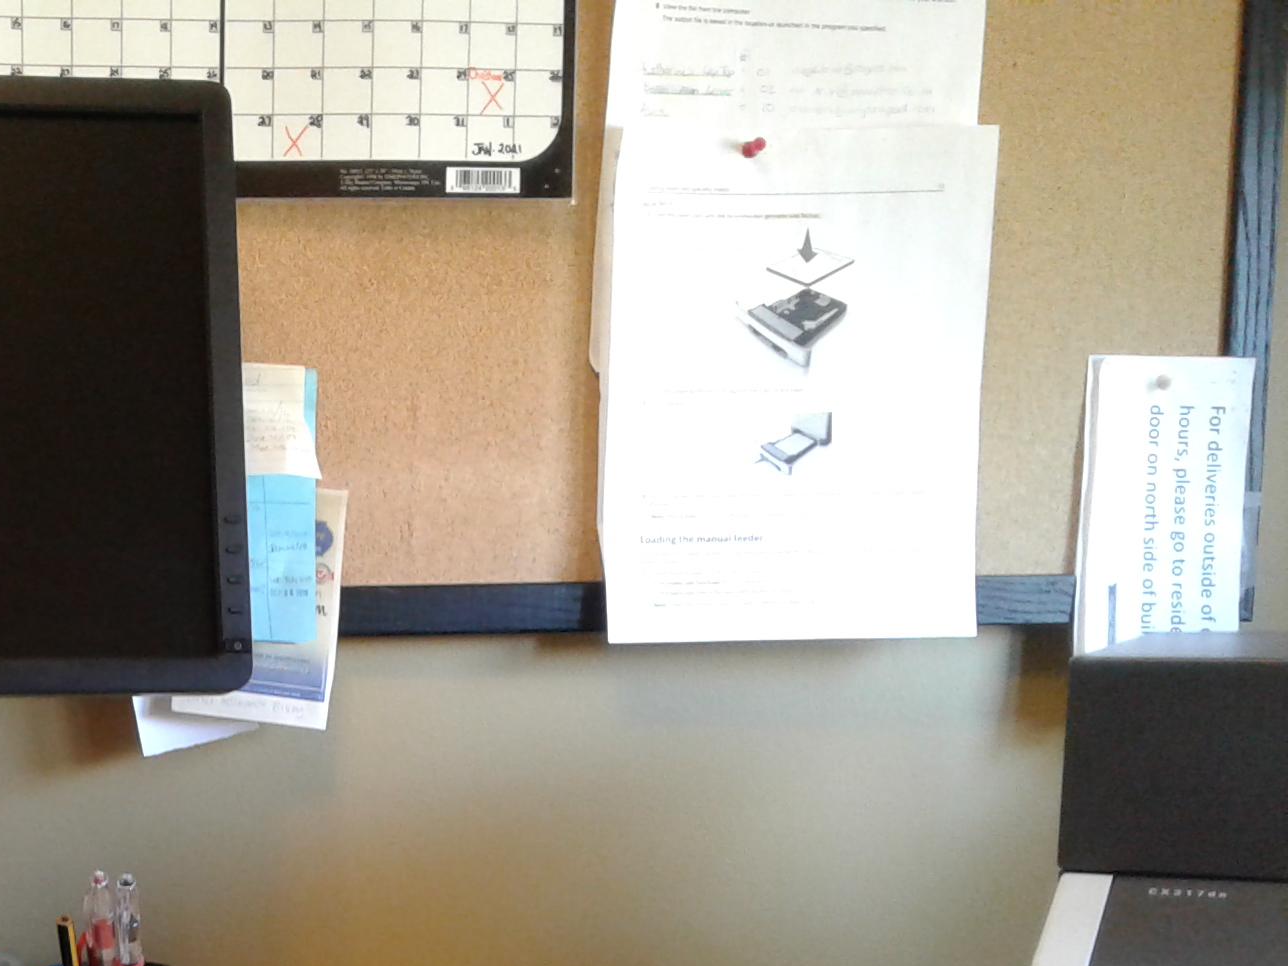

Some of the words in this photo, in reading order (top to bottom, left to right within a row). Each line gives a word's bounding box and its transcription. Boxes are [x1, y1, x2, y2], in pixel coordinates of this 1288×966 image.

[1148, 404, 1165, 448] door
[1173, 405, 1196, 462] hours,
[1209, 405, 1227, 436] For
[1146, 453, 1158, 476] on
[1173, 468, 1192, 525] please
[1204, 440, 1224, 527] deliveries
[1143, 482, 1160, 532] north
[1142, 536, 1158, 573] side
[1169, 530, 1186, 553] go
[1171, 559, 1186, 577] to
[1200, 532, 1217, 599] outside
[1142, 578, 1157, 598] of
[1200, 604, 1217, 624] of
